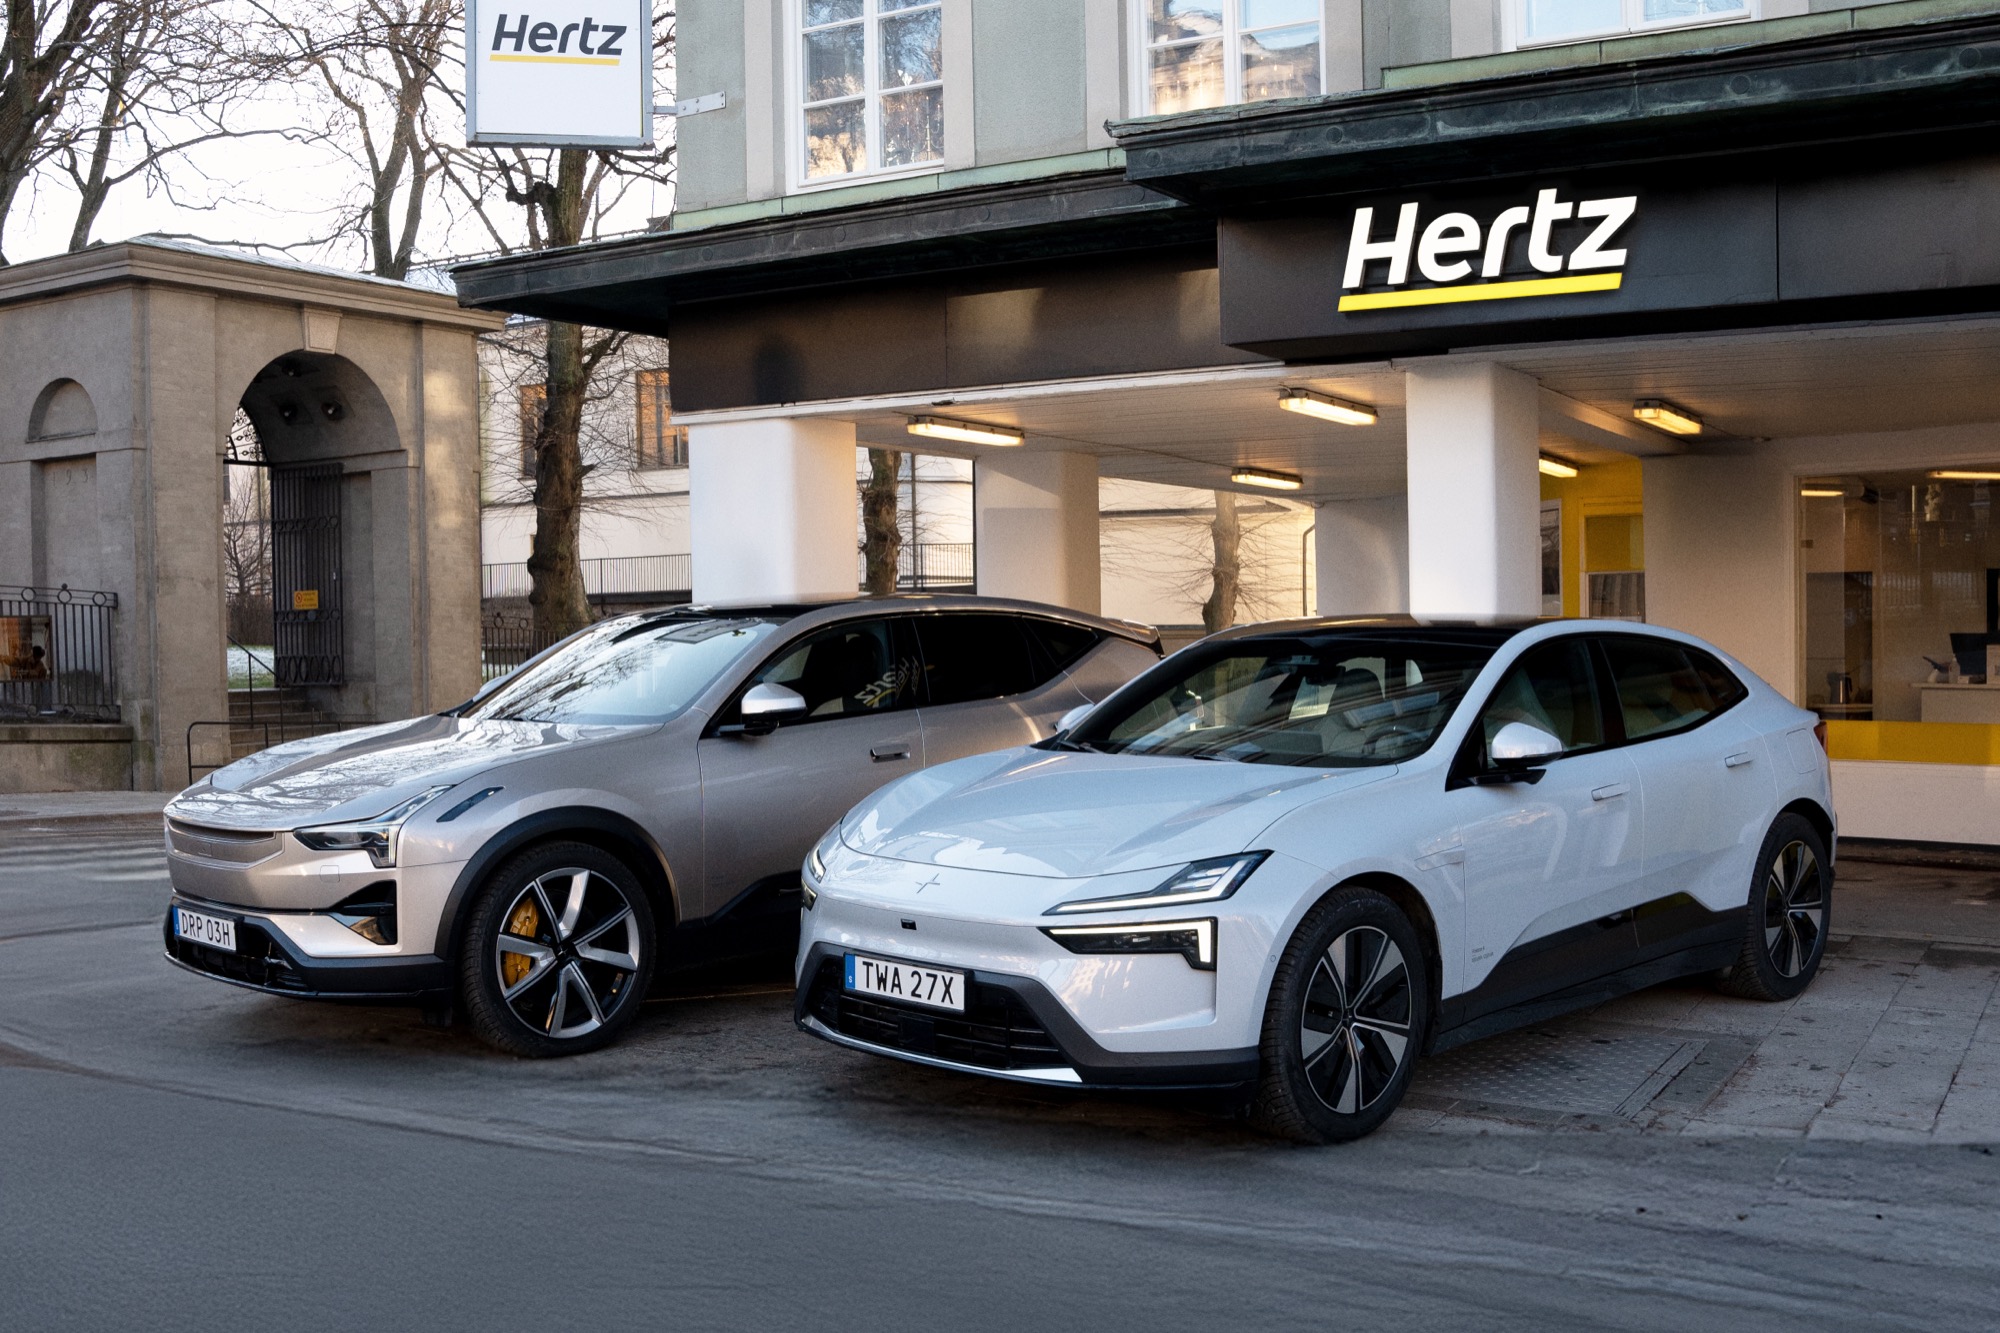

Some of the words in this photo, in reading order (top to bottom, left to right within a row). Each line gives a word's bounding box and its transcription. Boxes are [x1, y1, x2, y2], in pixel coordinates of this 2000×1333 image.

[491, 13, 627, 56] Hertz
[1342, 188, 1638, 289] Hertz
[181, 912, 203, 938] DRP
[206, 918, 231, 946] 03H
[848, 975, 853, 984] S
[862, 961, 903, 995] TWA
[910, 970, 954, 1005] 27X
